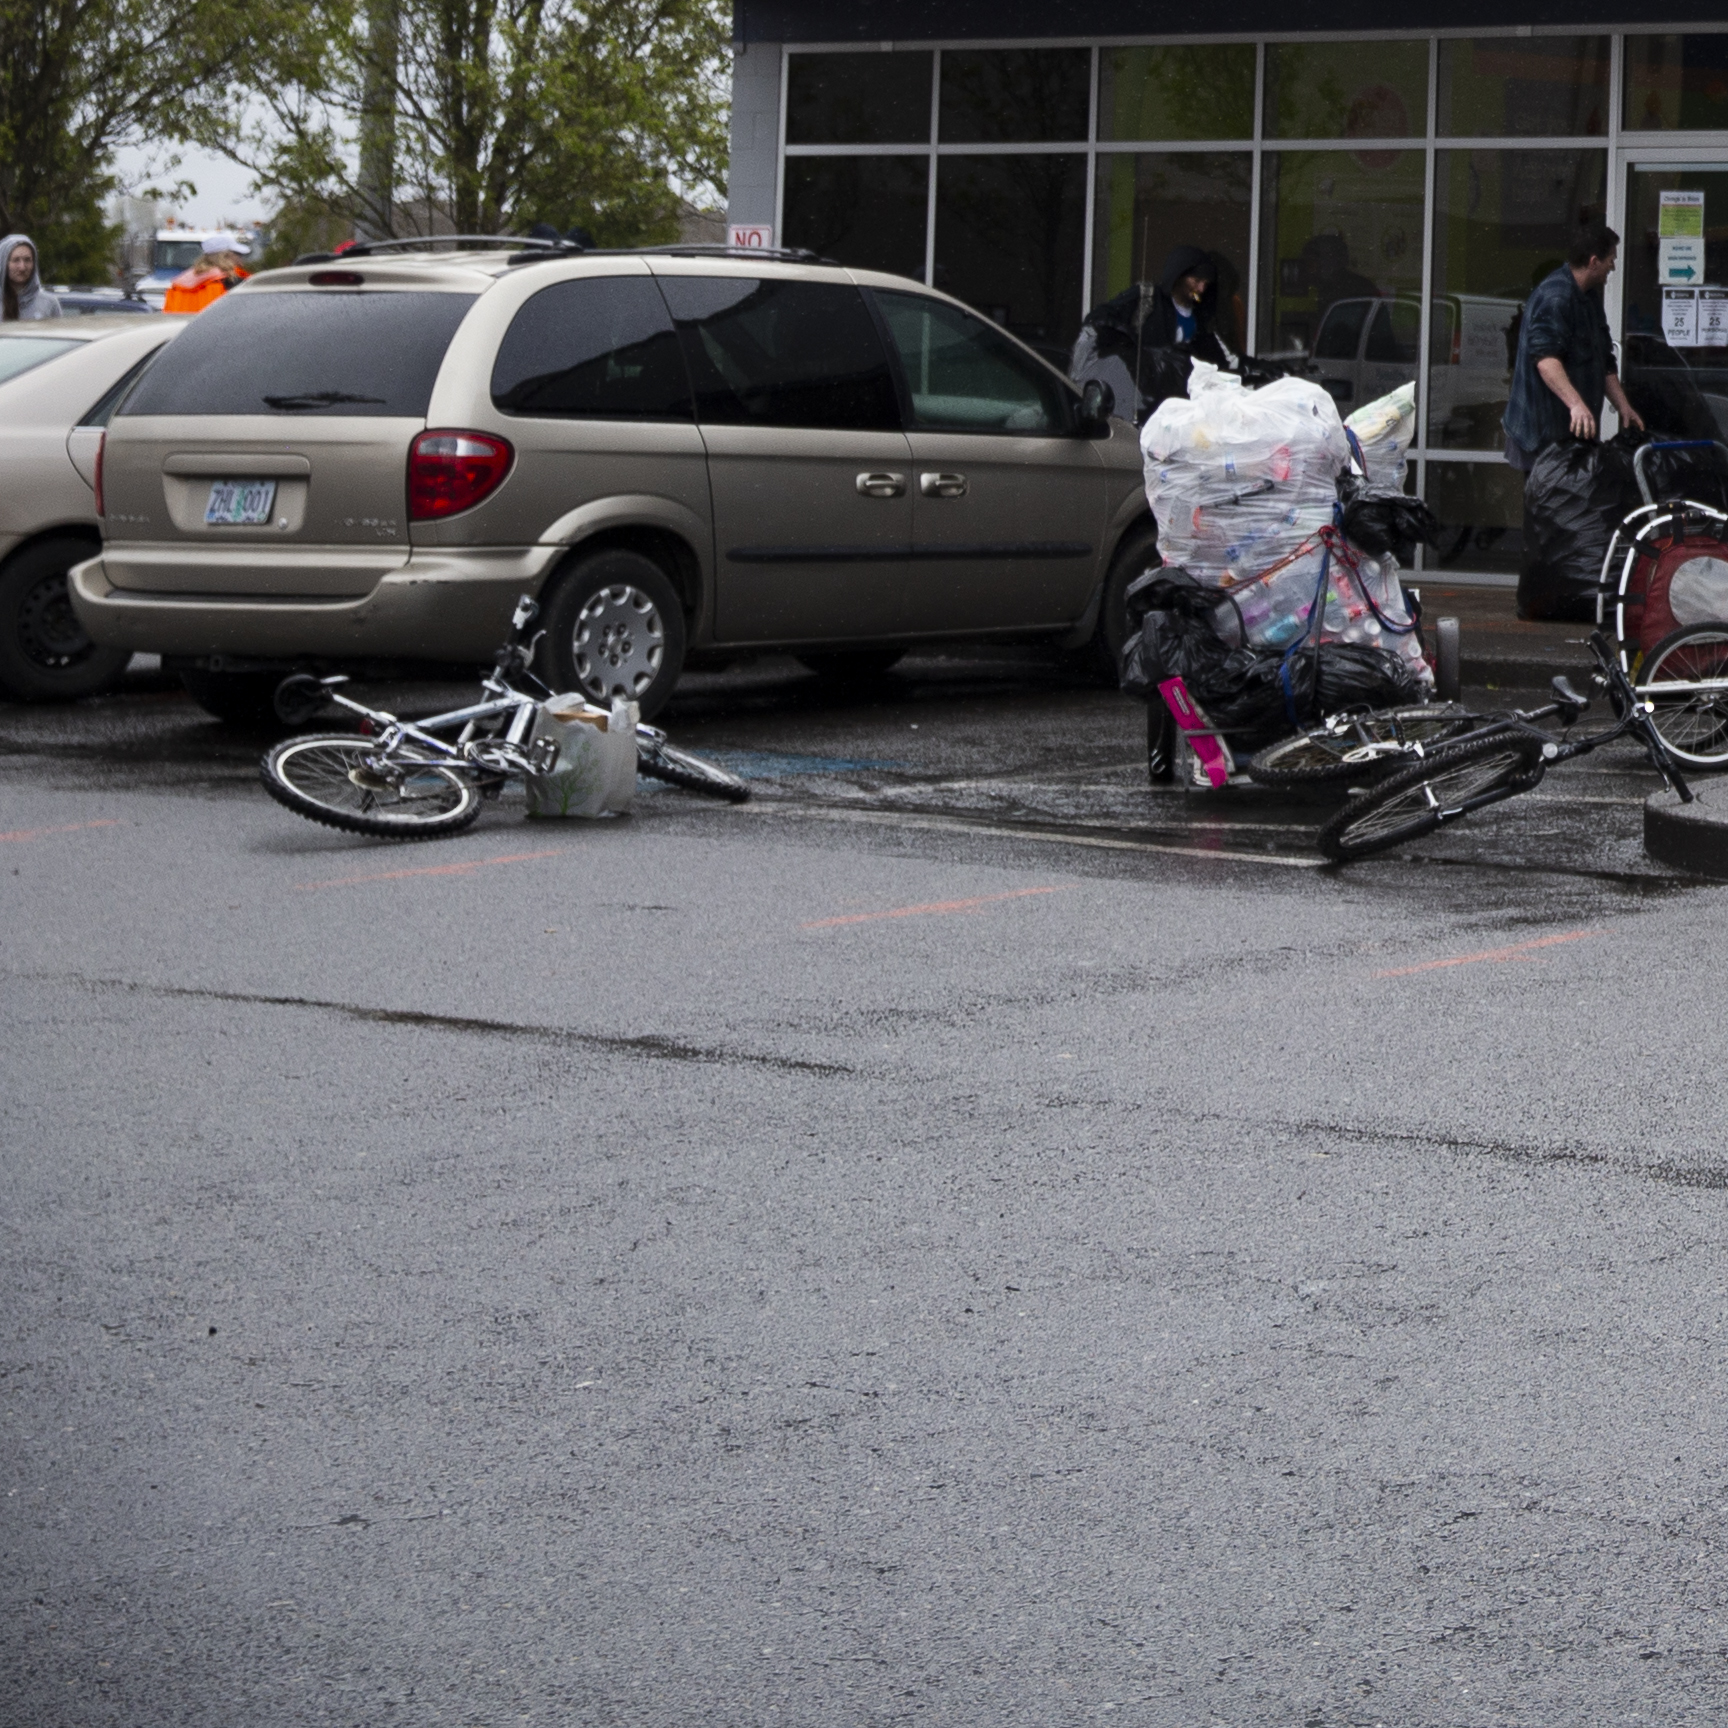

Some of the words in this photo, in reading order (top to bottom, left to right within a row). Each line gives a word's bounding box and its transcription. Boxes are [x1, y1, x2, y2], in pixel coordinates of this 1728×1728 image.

[735, 230, 762, 248] NO
[1674, 317, 1685, 327] 25
[1709, 316, 1721, 327] 25
[1667, 328, 1691, 337] PEOPLE
[242, 489, 269, 514] 001
